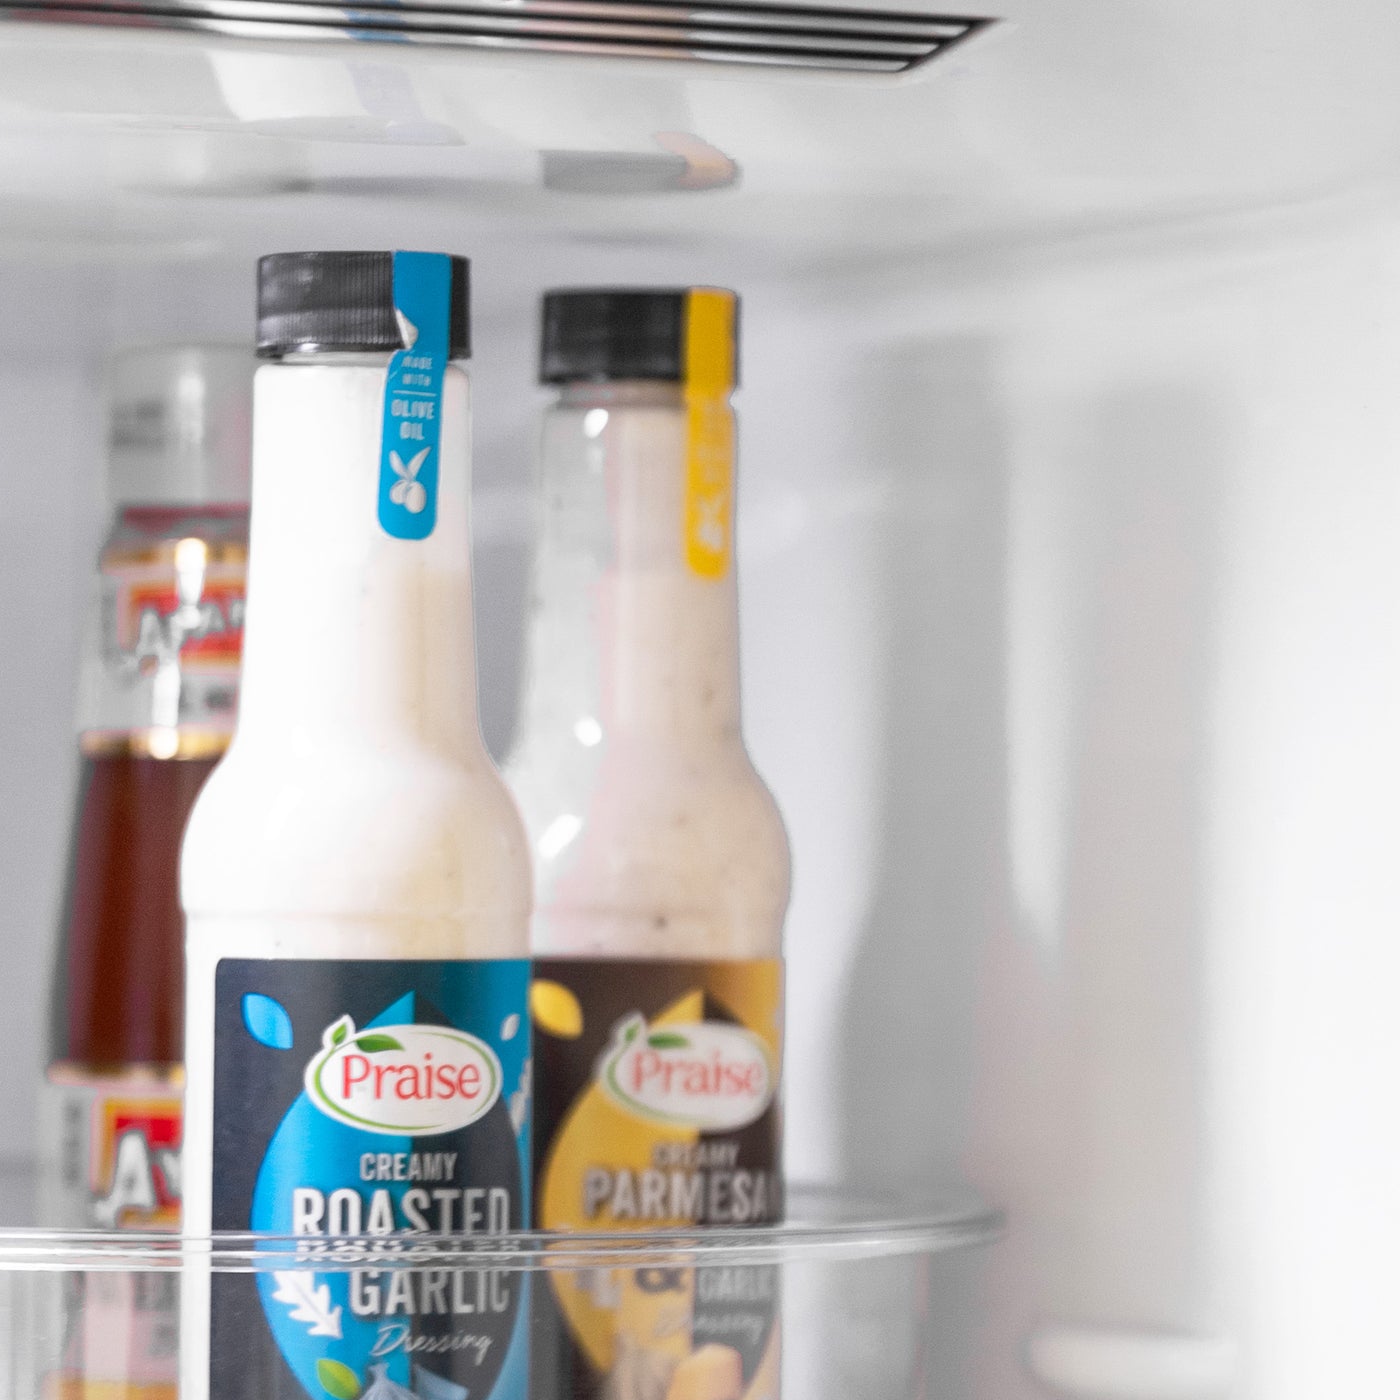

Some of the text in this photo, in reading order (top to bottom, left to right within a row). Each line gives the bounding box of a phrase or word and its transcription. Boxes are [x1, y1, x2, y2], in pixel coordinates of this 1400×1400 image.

[391, 399, 434, 419] OLIVE
[400, 421, 425, 440] OIL
[341, 1052, 482, 1100] Praise
[630, 1049, 762, 1098] Praise
[358, 1152, 458, 1182] CREAMY
[292, 1187, 511, 1239] ROASTED
[583, 1166, 780, 1222] PARMESA
[349, 1269, 511, 1317] GARLIC
[370, 1323, 495, 1366] Dressing
